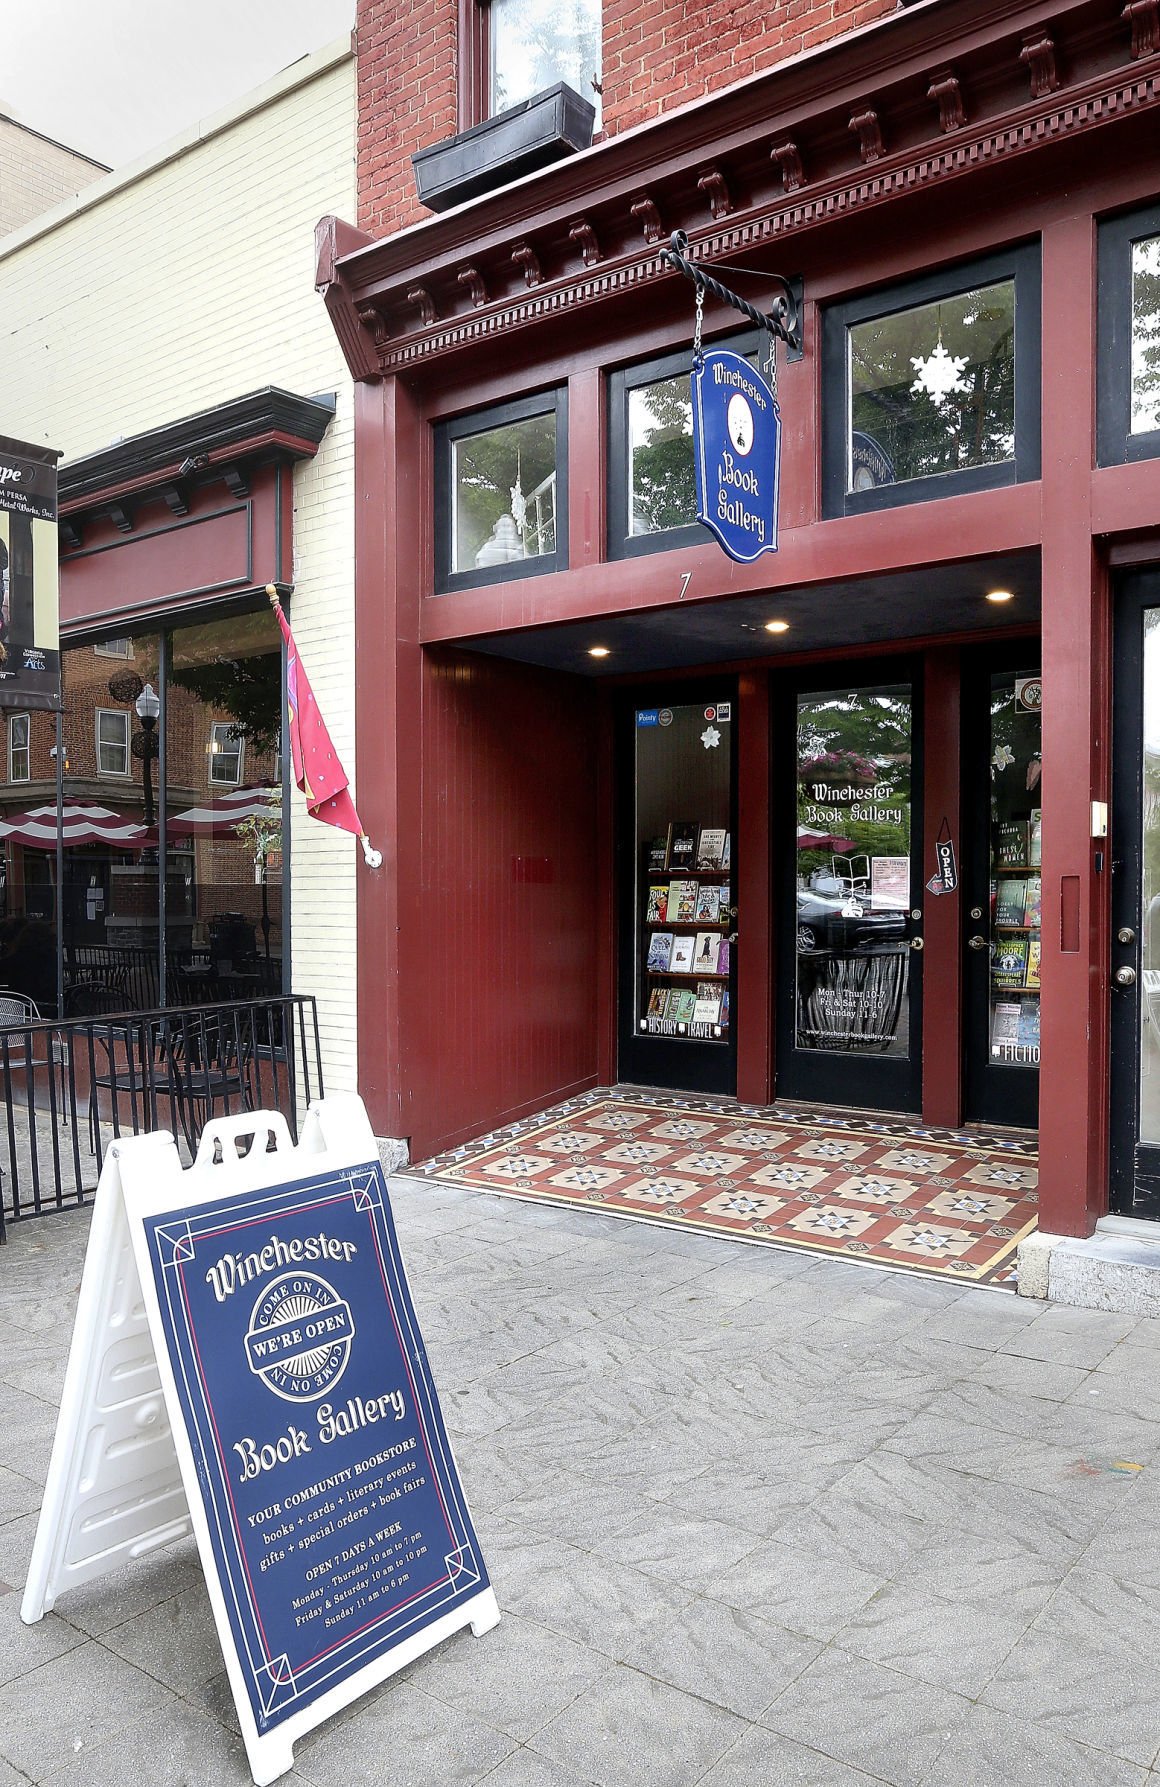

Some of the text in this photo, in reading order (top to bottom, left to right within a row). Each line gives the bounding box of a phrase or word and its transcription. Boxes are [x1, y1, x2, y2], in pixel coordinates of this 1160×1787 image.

[712, 362, 767, 410] Winchester
[722, 450, 759, 496] Book
[7, 490, 27, 502] PERSA
[17, 503, 40, 517] Works,
[42, 509, 54, 518] Inc.
[718, 489, 765, 542] Gallery
[679, 571, 691, 598] 7
[24, 657, 45, 670] Arts
[848, 694, 857, 709] 7
[806, 804, 902, 823] Book Gallery
[812, 784, 893, 801] Winchester
[940, 847, 954, 889] OPEN
[818, 988, 835, 996] Mon
[825, 1009, 855, 1018] Sunday
[843, 999, 856, 1007] Sat
[648, 1018, 713, 1039] HISTORY TRAVEL
[1005, 1044, 1040, 1063] FICTIO
[206, 1233, 357, 1302] Winchester
[259, 1281, 330, 1325] COME ON IN
[253, 1313, 345, 1357] WE'RE OPEN
[271, 1346, 341, 1391] COME ON IN
[233, 1390, 406, 1482] Book Gallery
[248, 1438, 417, 1527] YOUR COMMUNITY BOOKSTORE
[263, 1461, 416, 1544] books + cards + literary events
[260, 1476, 425, 1571] gifts + special orders + book fairs
[292, 1587, 324, 1609] Monday
[332, 1561, 368, 1586] Thursday
[371, 1555, 380, 1564] 10
[382, 1549, 393, 1558] am
[395, 1542, 402, 1551] to
[404, 1537, 409, 1545] 7
[410, 1532, 422, 1543] pm
[305, 1521, 402, 1581] OPEN 7 DAYS A WEEK
[295, 1545, 428, 1627] Friday & Saturday 10 am to 10 pm
[325, 1573, 409, 1628] Sunday 11 am to 6 pm
